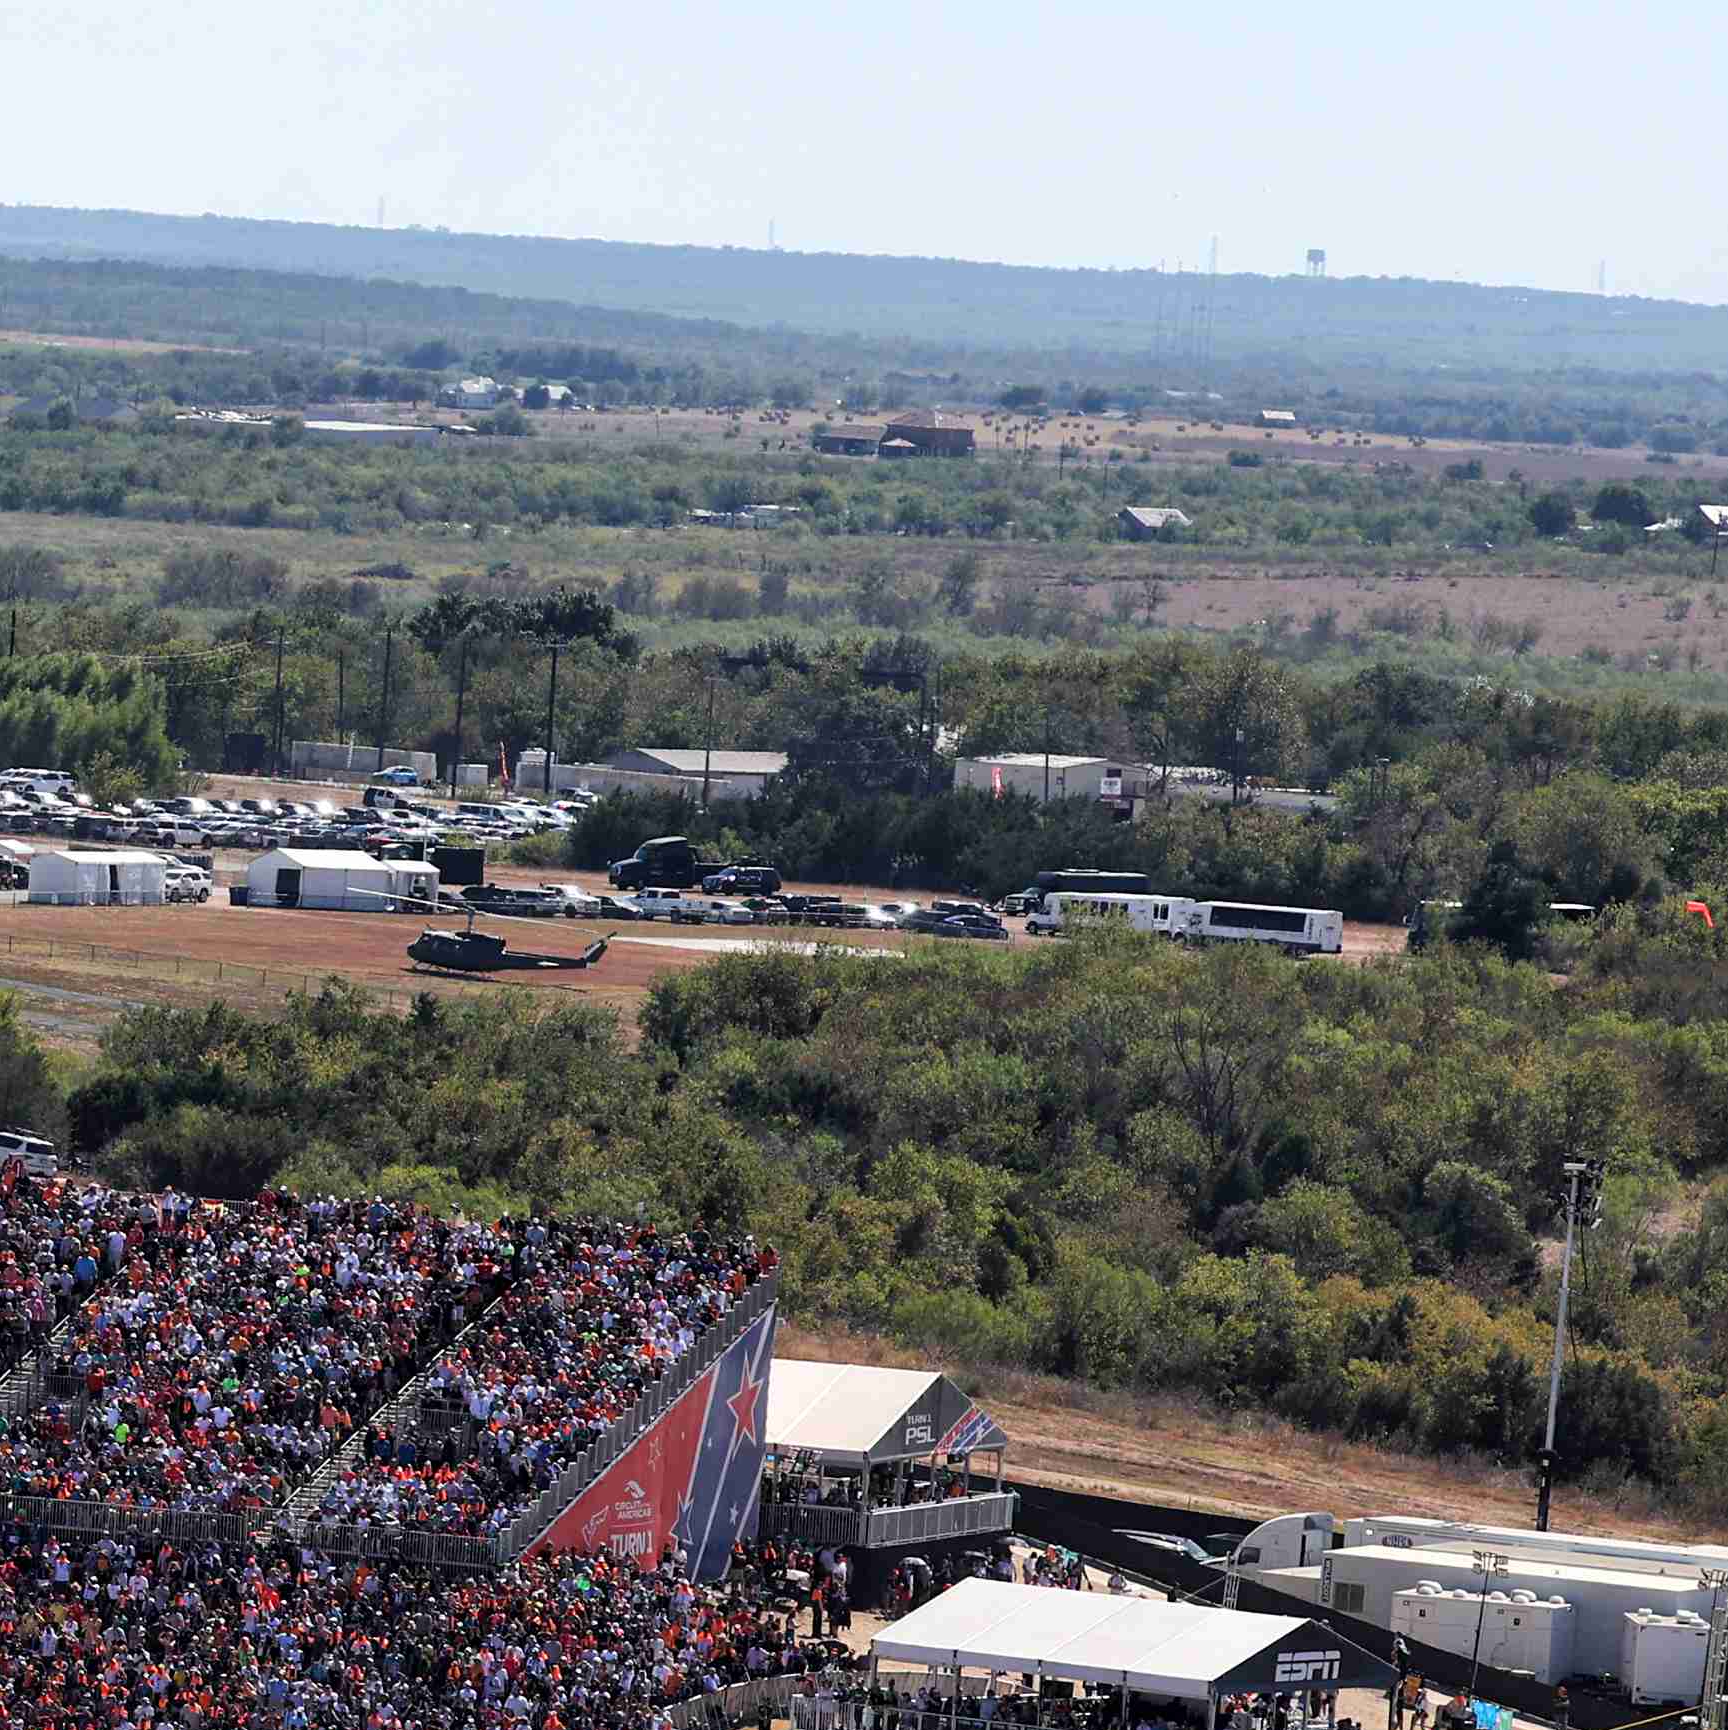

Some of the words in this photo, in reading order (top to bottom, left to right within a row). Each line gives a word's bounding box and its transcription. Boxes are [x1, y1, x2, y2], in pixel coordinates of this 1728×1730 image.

[905, 1425, 936, 1446] PSL
[610, 1531, 646, 1558] TURN
[1274, 1650, 1342, 1682] ESPN
